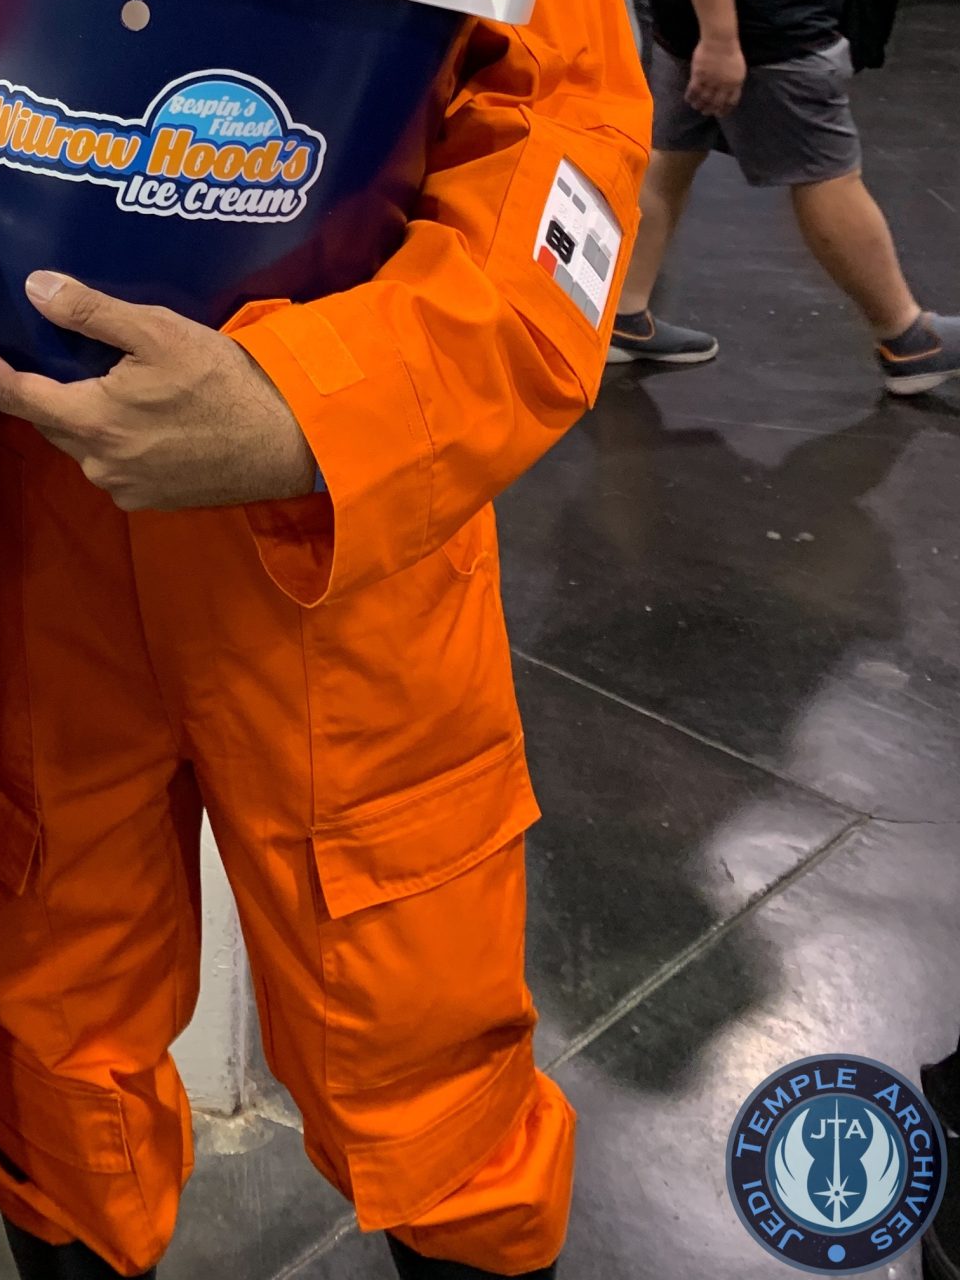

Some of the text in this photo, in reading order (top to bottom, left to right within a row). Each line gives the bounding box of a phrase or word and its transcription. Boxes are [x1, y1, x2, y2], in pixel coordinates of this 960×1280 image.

[169, 95, 257, 118] Bespin's
[208, 116, 279, 137] Finest
[146, 127, 311, 182] Hood's
[125, 175, 298, 214] Ice Cream
